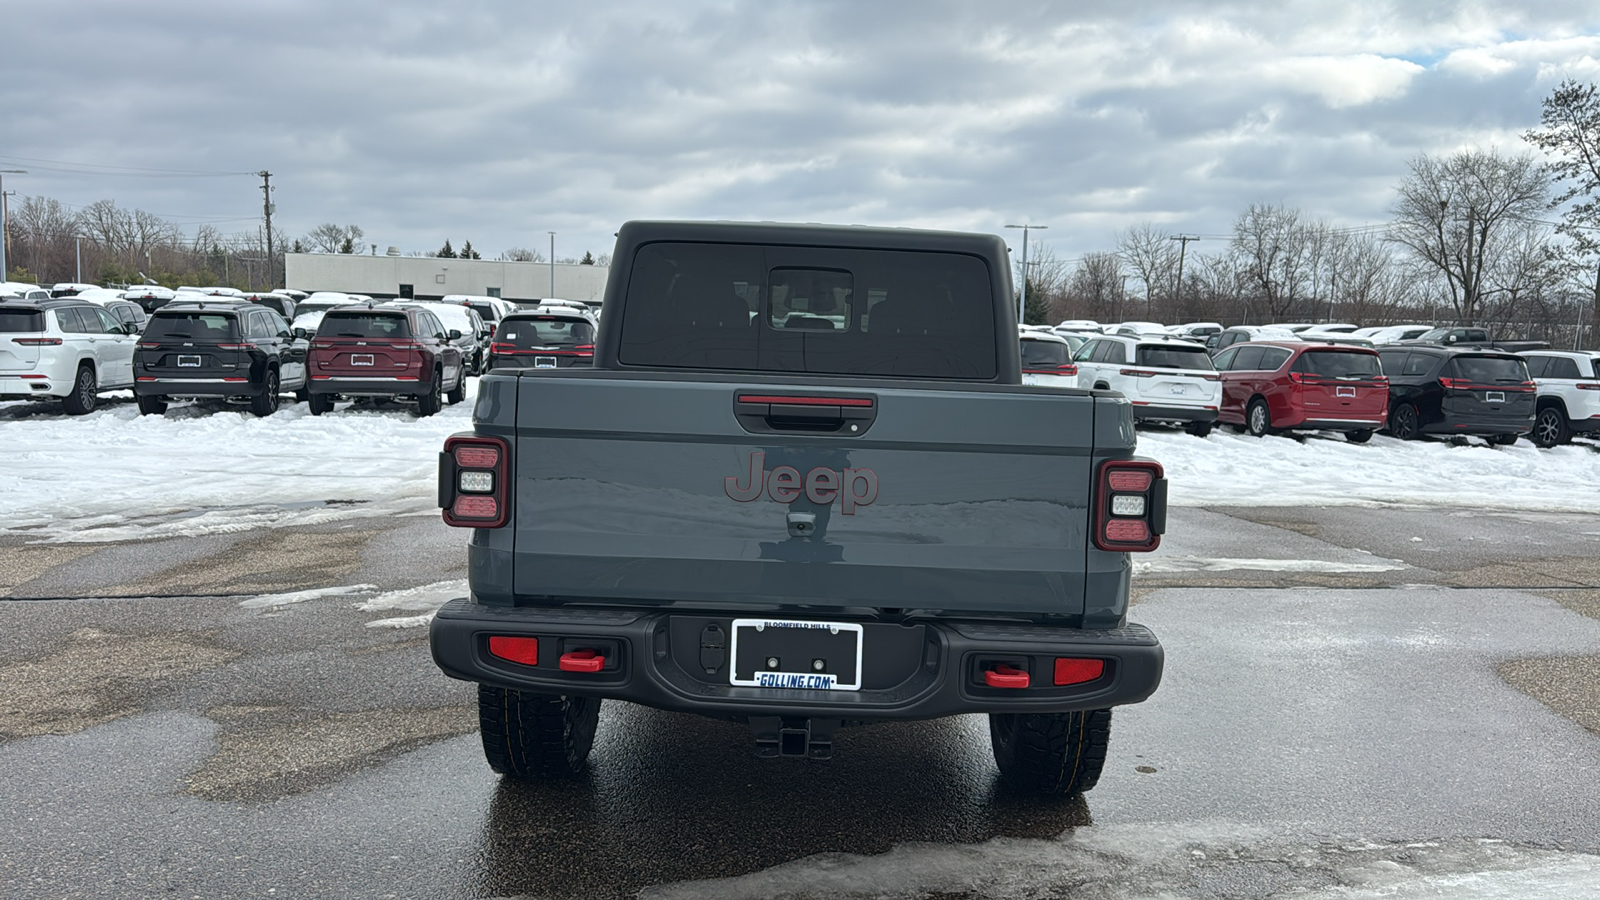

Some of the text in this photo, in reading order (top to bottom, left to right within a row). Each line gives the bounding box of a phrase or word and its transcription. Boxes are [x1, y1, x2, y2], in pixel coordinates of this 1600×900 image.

[724, 453, 879, 516] Jeep
[764, 621, 809, 629] BLOOMFIELD
[760, 674, 831, 690] GOLLING.COM
